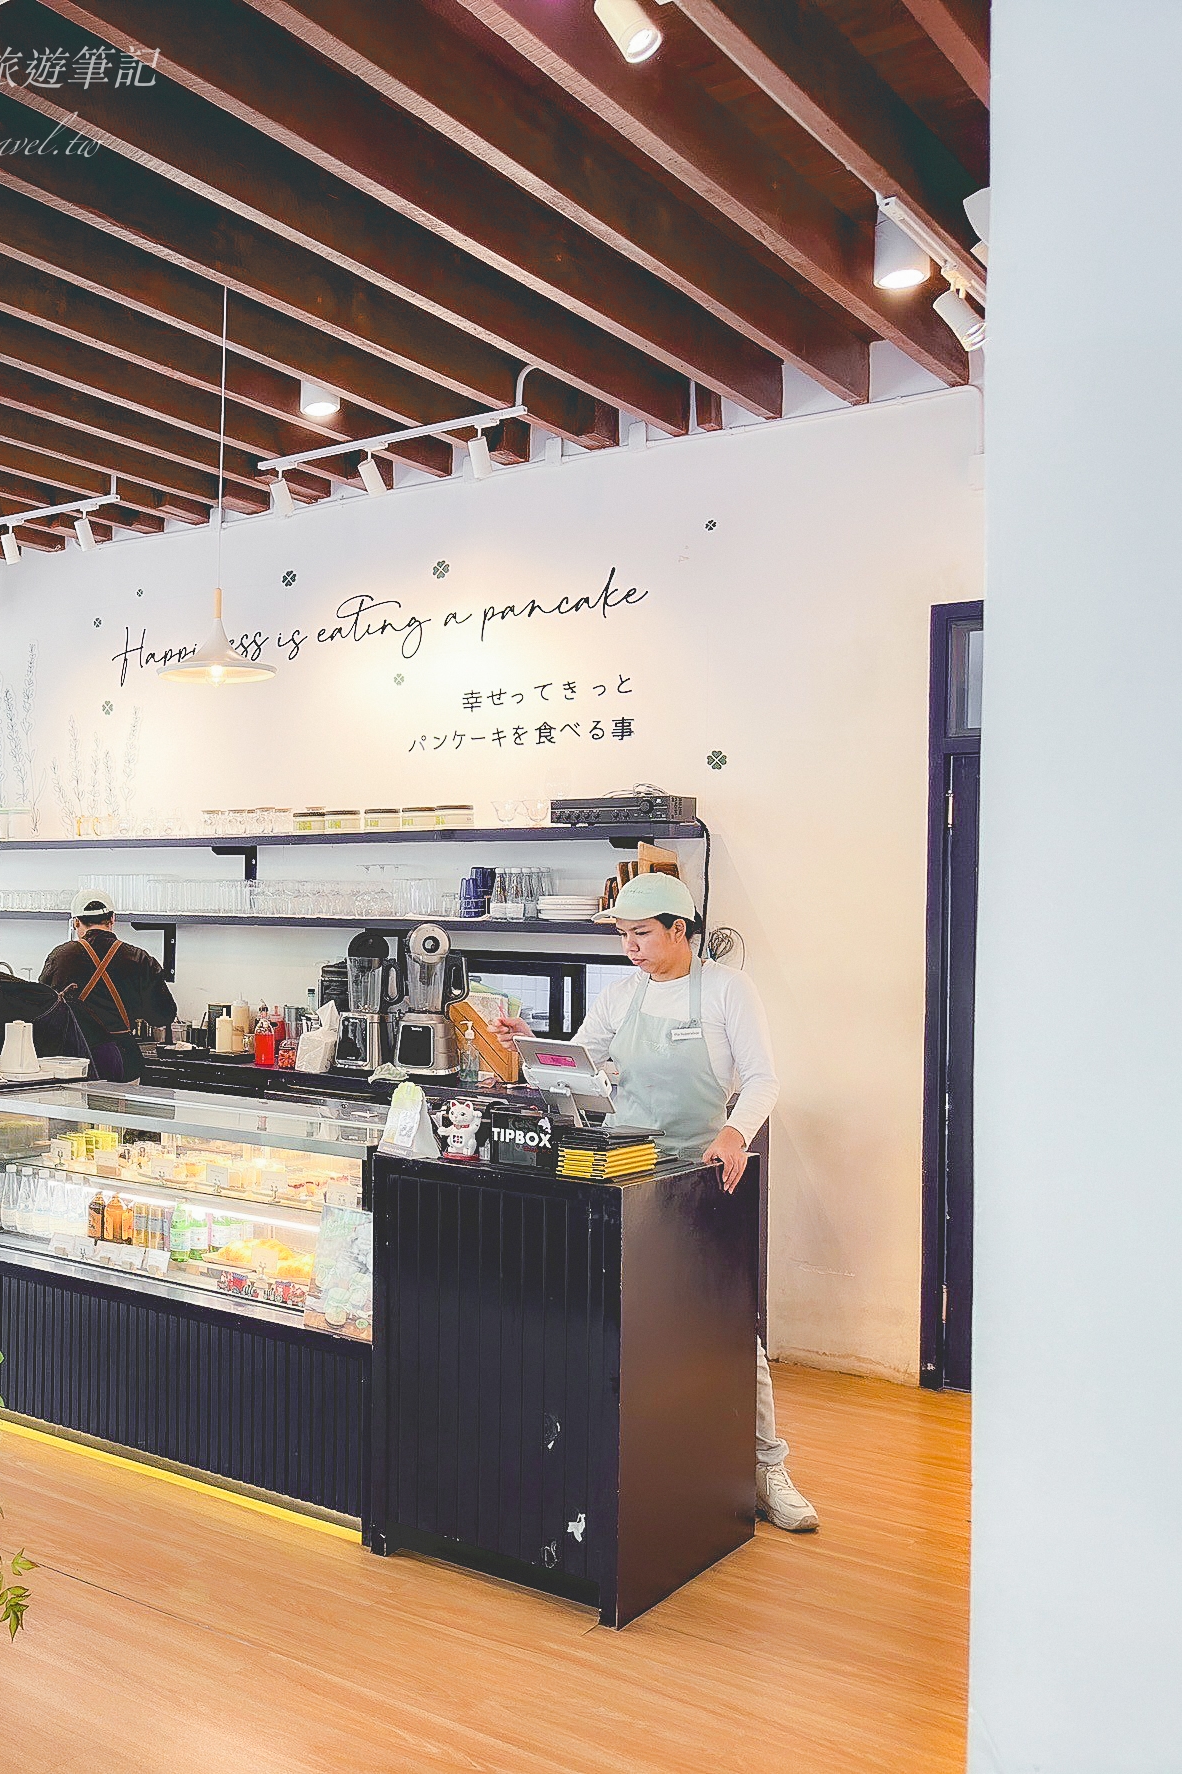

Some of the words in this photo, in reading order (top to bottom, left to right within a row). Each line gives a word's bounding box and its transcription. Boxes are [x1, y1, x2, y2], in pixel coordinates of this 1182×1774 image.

[111, 626, 271, 688] Happiess
[277, 629, 309, 661] is
[317, 594, 432, 659] eating
[443, 612, 472, 627] a
[480, 566, 649, 642] pancake
[462, 673, 633, 713] 幸せってきっと
[408, 716, 636, 753] パンケーキを食べる事
[491, 1127, 552, 1149] TIPBOX
